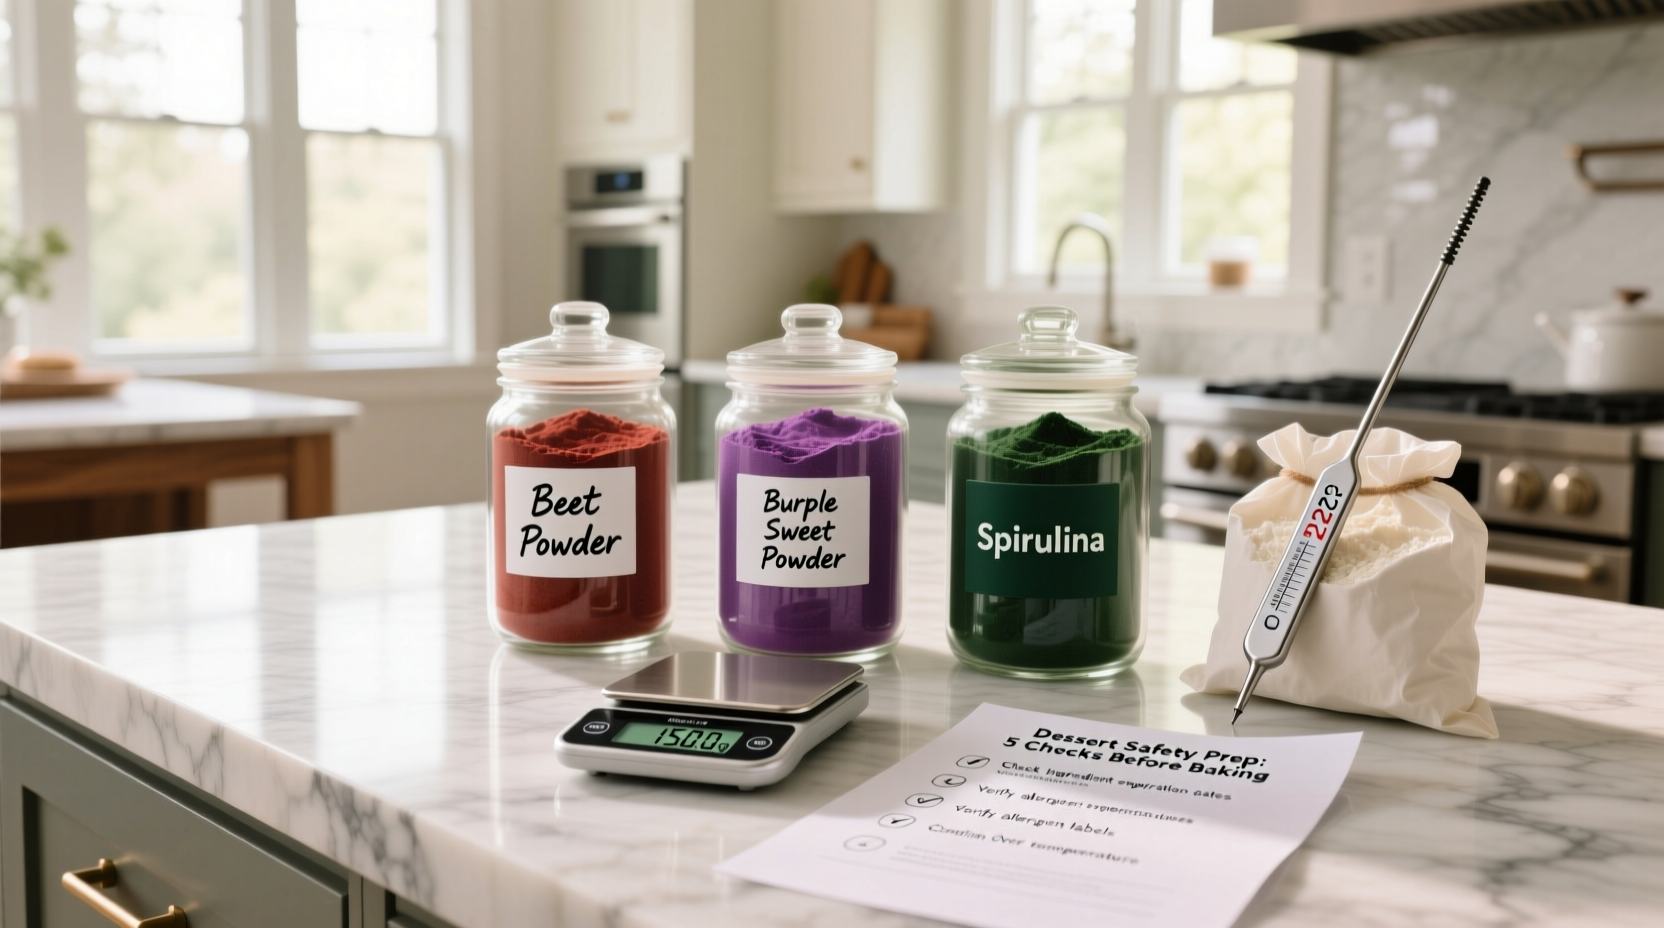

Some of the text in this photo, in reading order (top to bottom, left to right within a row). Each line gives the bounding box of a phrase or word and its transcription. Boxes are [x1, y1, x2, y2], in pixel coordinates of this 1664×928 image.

[531, 483, 602, 517] Beet
[763, 488, 839, 522] Burple
[520, 524, 622, 557] Powder
[763, 518, 836, 542] Sweet
[977, 522, 1105, 560] Spirulina
[761, 545, 847, 570] Powder
[1002, 736, 1270, 784] 5 Checks Before Baking
[1033, 727, 1267, 769] Dessert Safety Prep:
